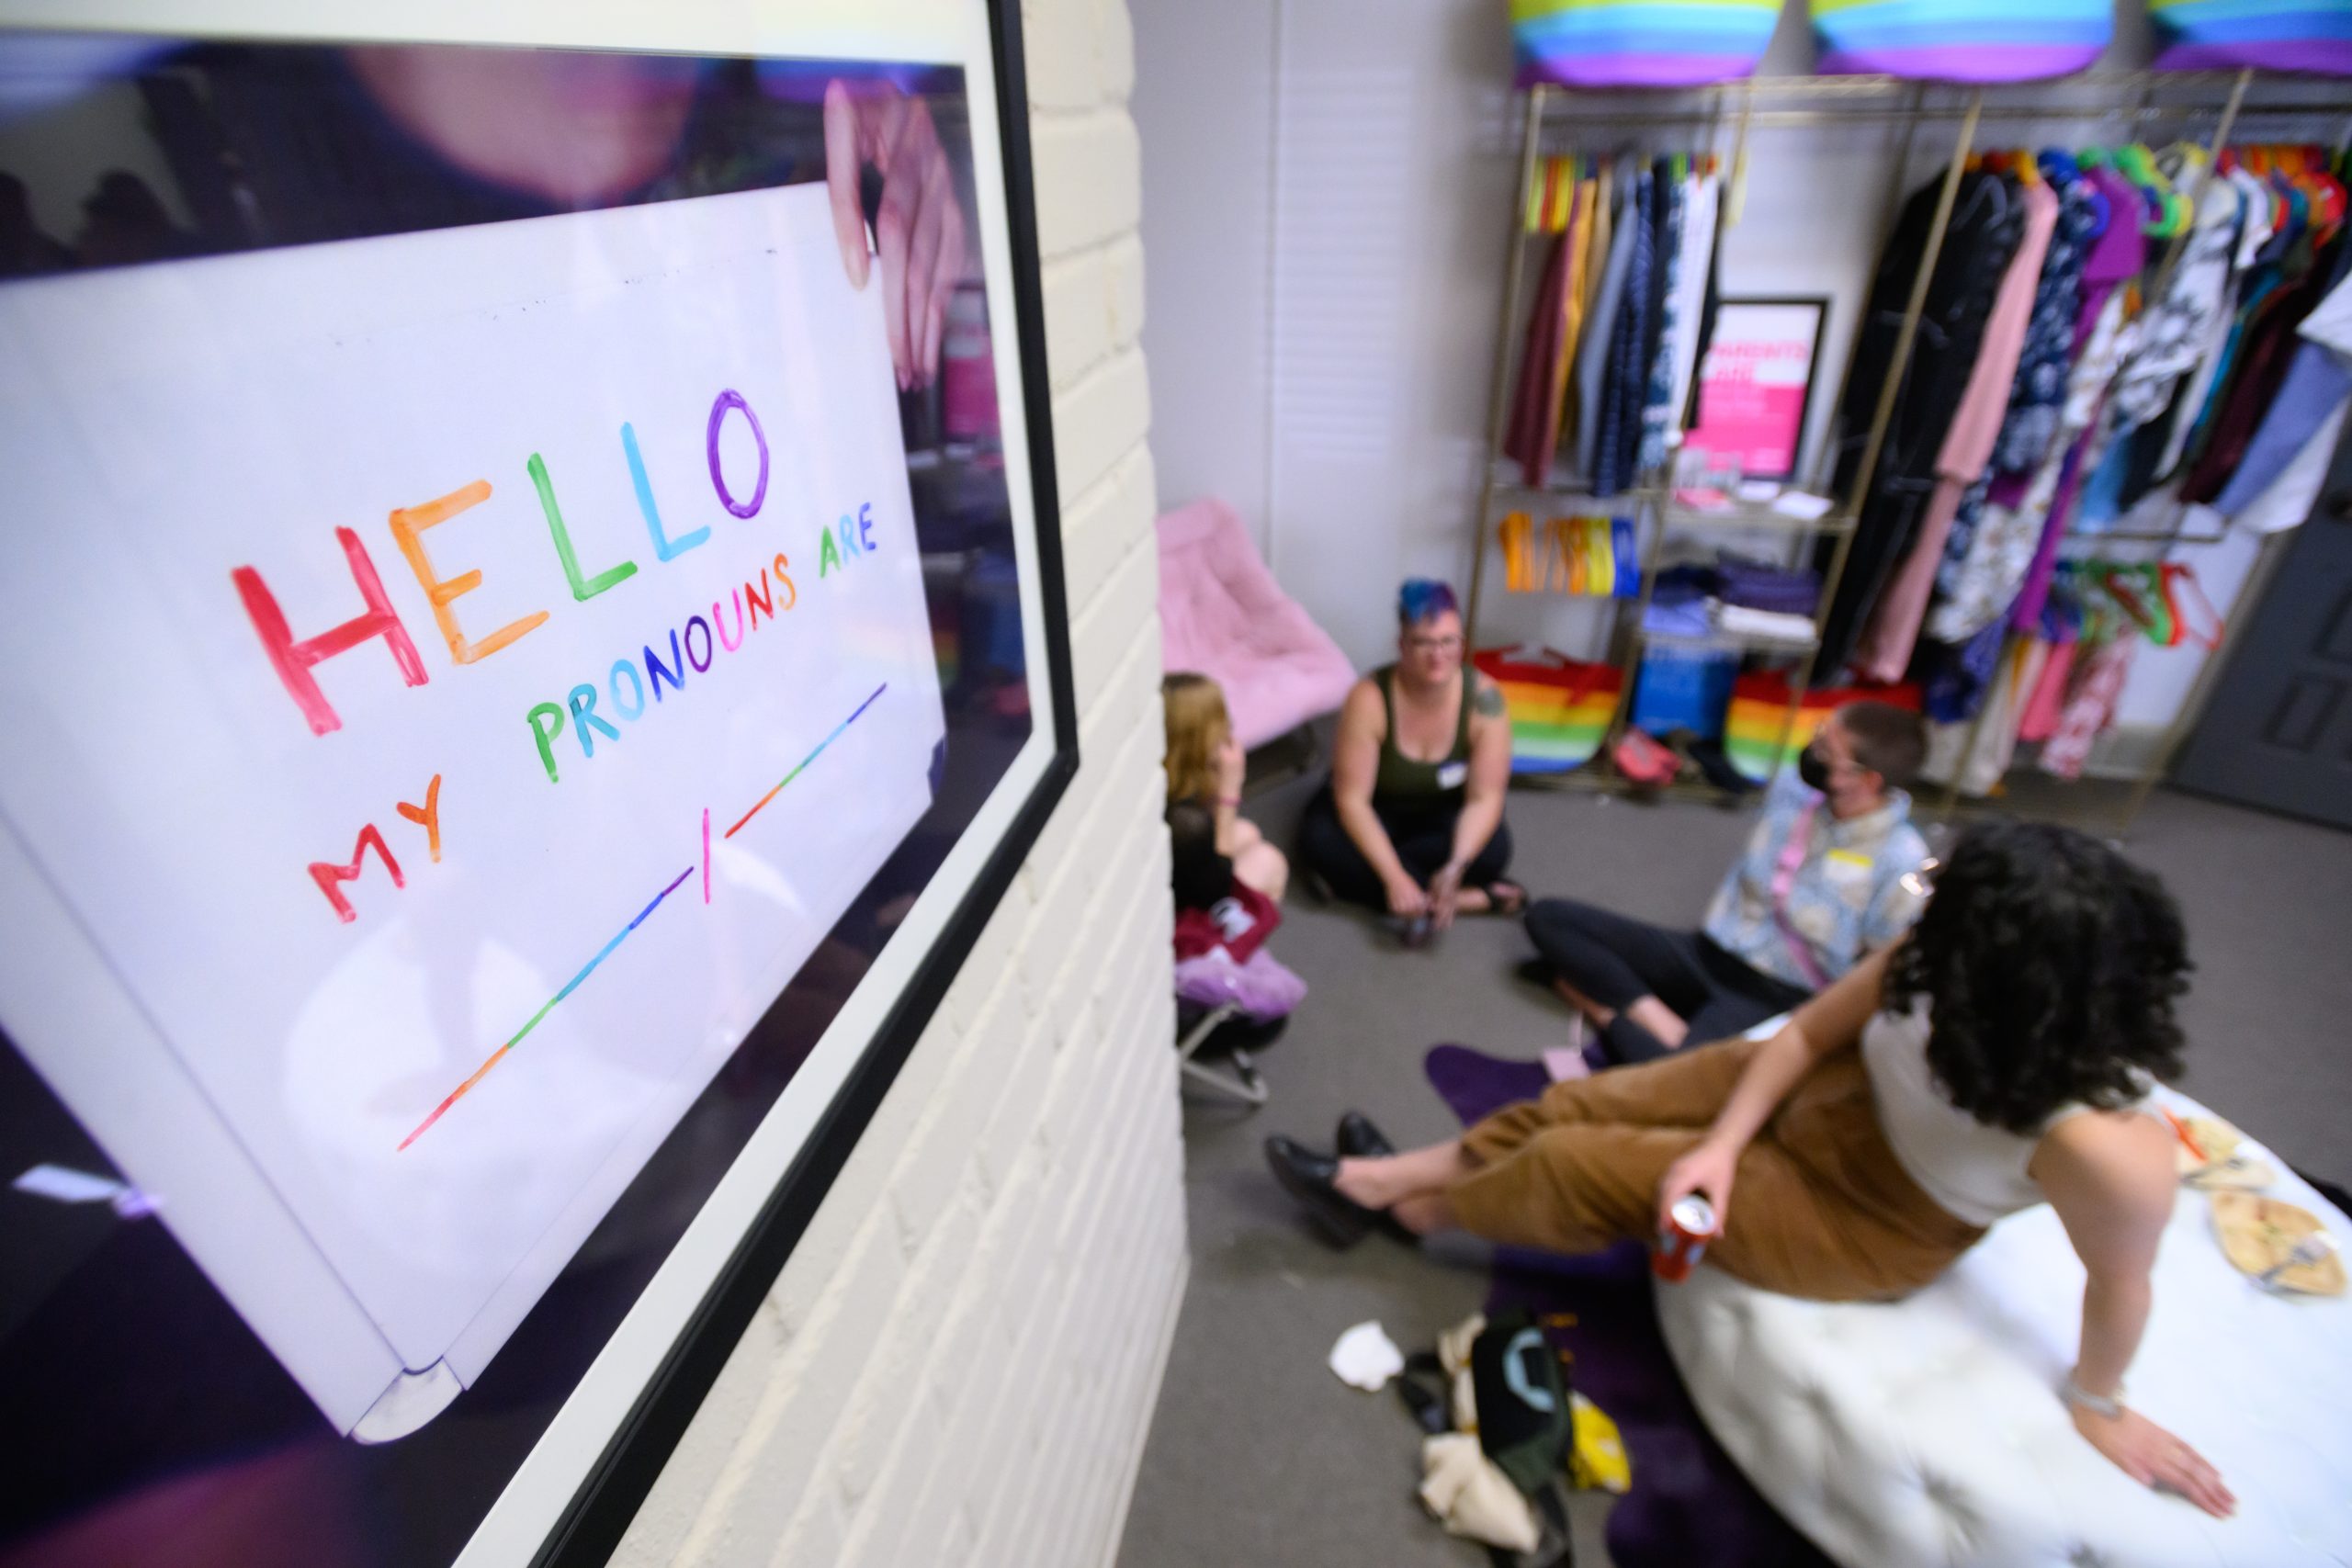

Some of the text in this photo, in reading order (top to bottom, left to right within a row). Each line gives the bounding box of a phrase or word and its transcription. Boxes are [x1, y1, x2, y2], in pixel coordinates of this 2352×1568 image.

[232, 389, 769, 736] HELLO
[308, 502, 877, 922] MY PRONOUNS ARE
